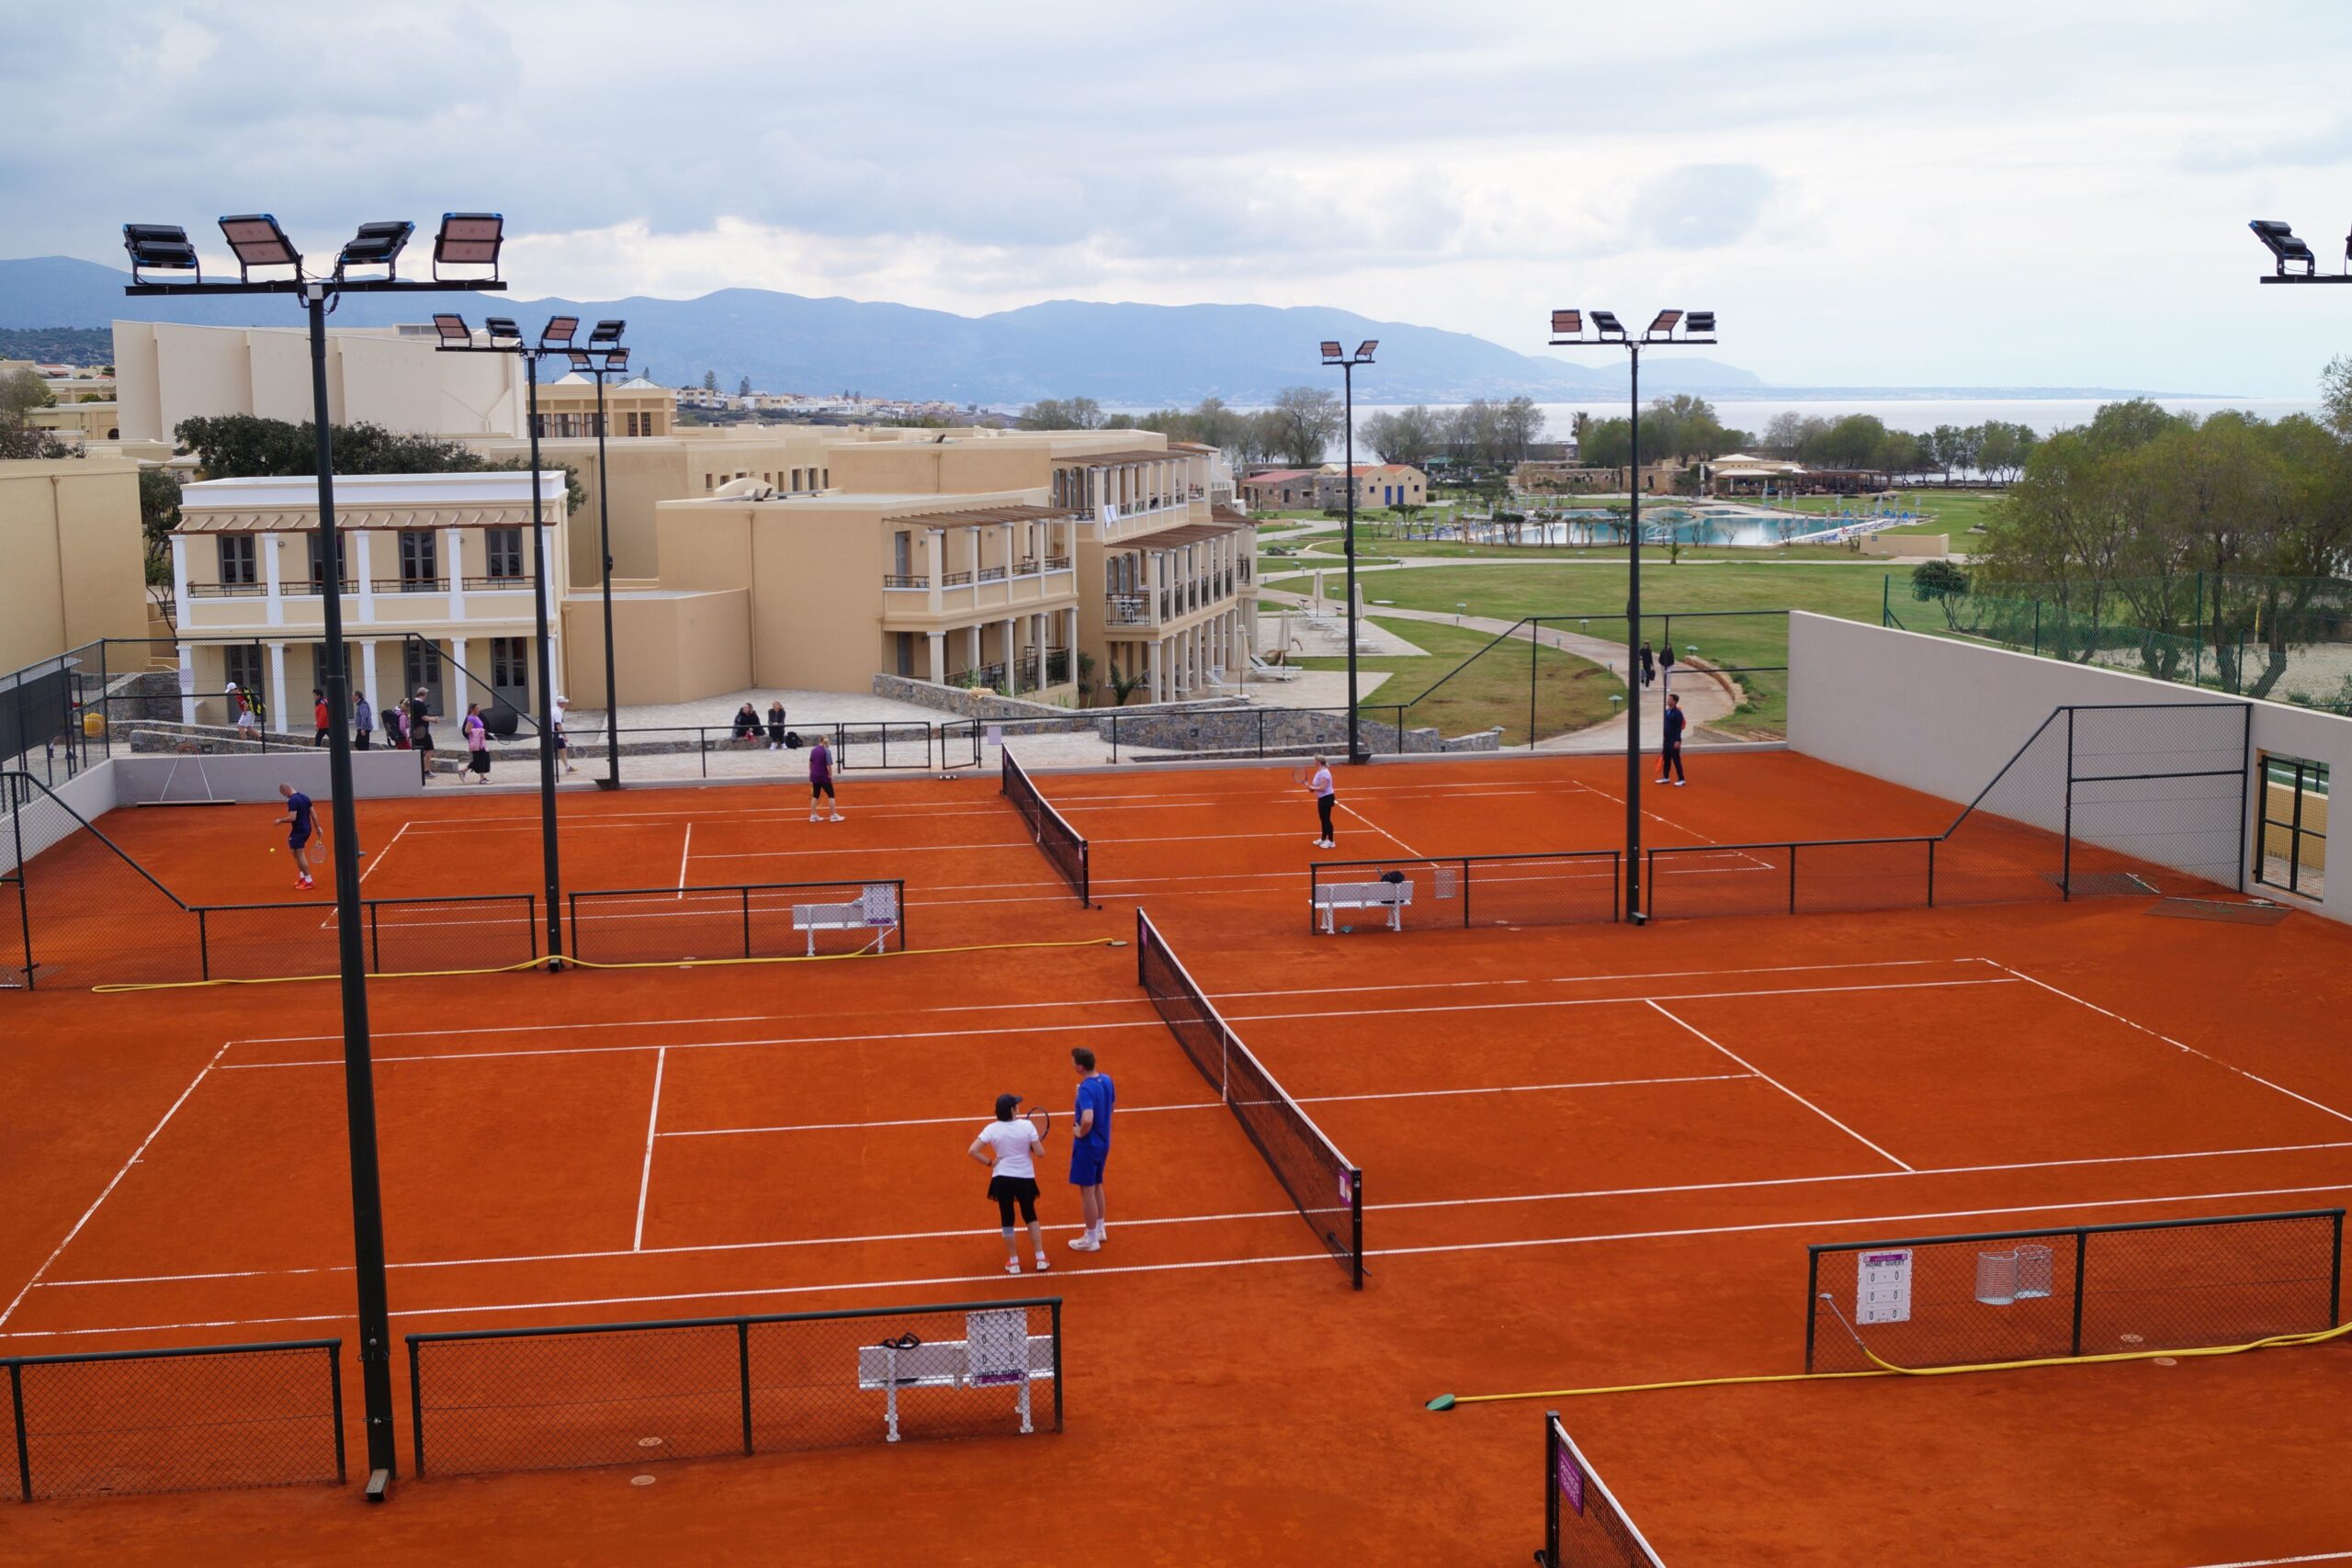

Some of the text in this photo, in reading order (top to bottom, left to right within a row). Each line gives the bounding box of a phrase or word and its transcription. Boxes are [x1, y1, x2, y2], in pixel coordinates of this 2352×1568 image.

[1871, 1271, 1899, 1282] 0 0
[1870, 1291, 1898, 1301] 0 0
[1869, 1309, 1897, 1320] 0 0
